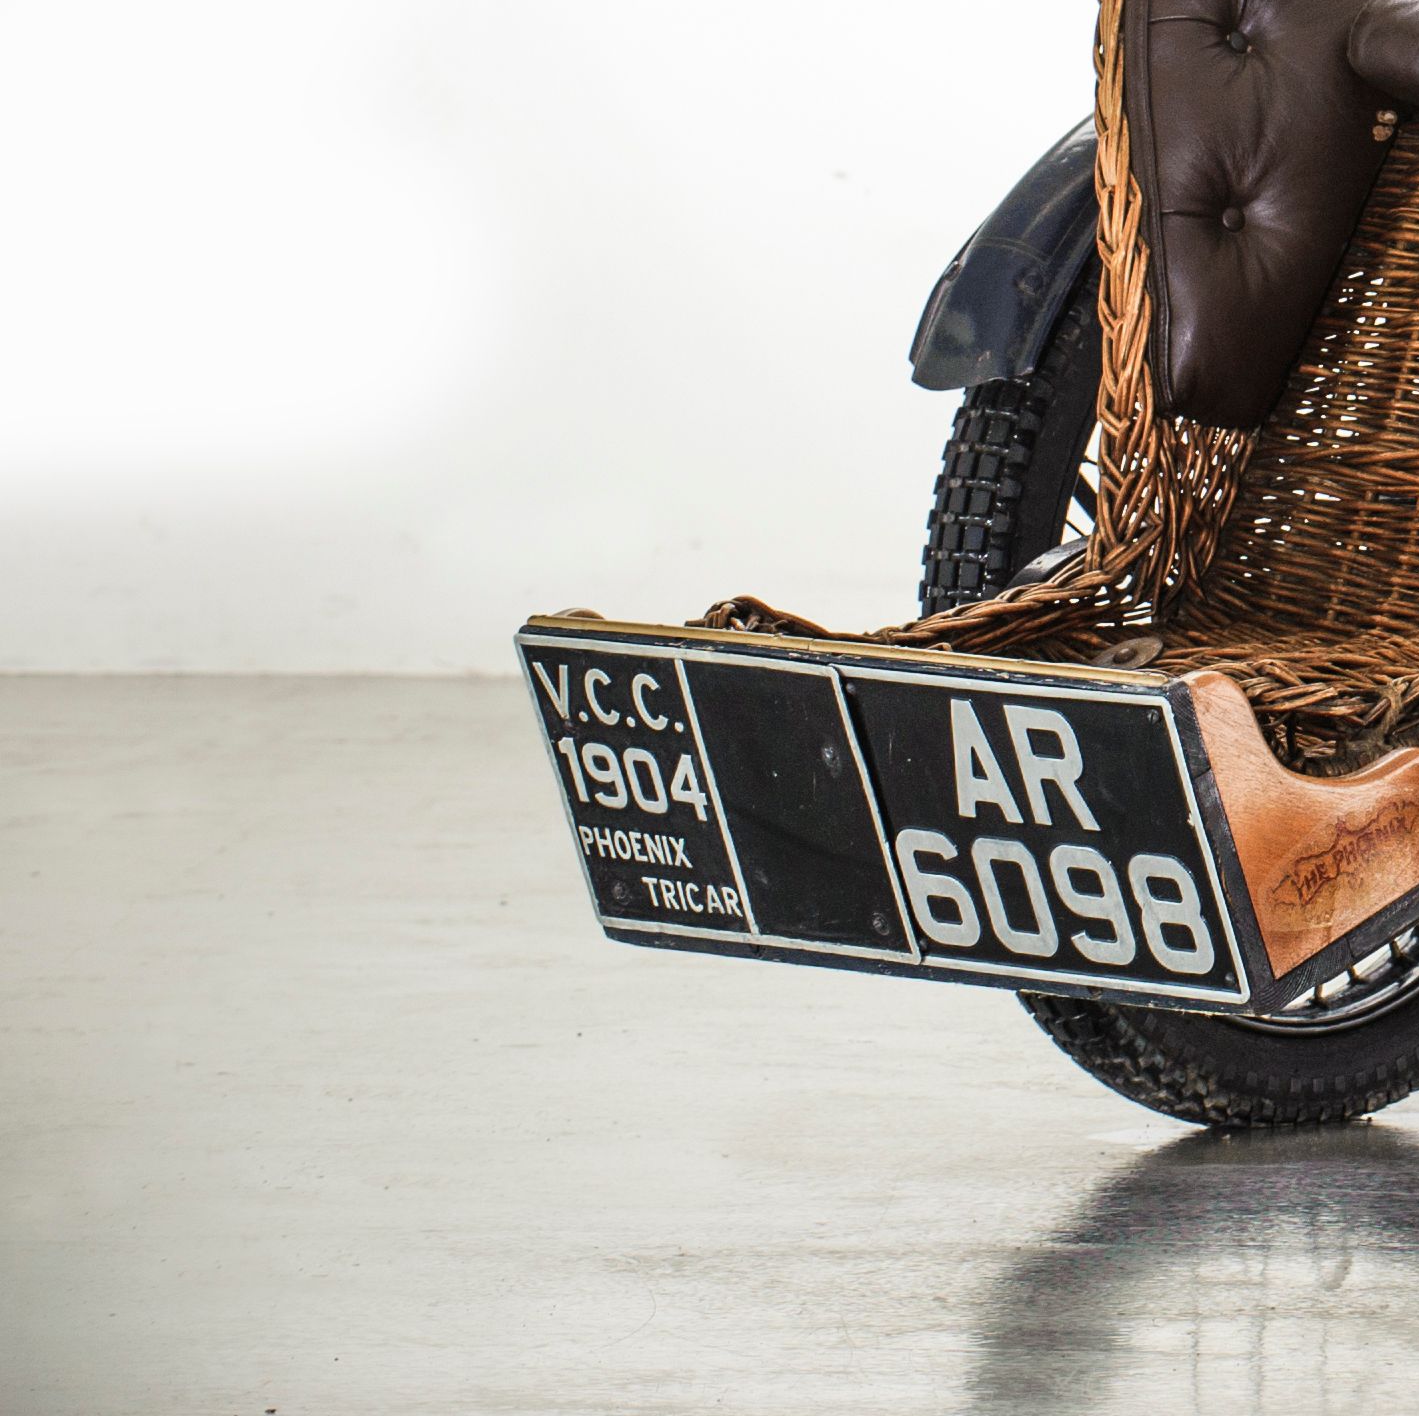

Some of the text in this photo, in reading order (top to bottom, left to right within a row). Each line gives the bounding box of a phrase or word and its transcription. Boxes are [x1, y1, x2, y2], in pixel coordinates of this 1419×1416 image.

[532, 661, 684, 733] V.C.C.
[558, 737, 707, 822] 1904
[950, 698, 1101, 831] AR
[578, 825, 693, 869] PHOENIX
[641, 876, 743, 918] TRICAR
[895, 828, 1215, 975] 6098
